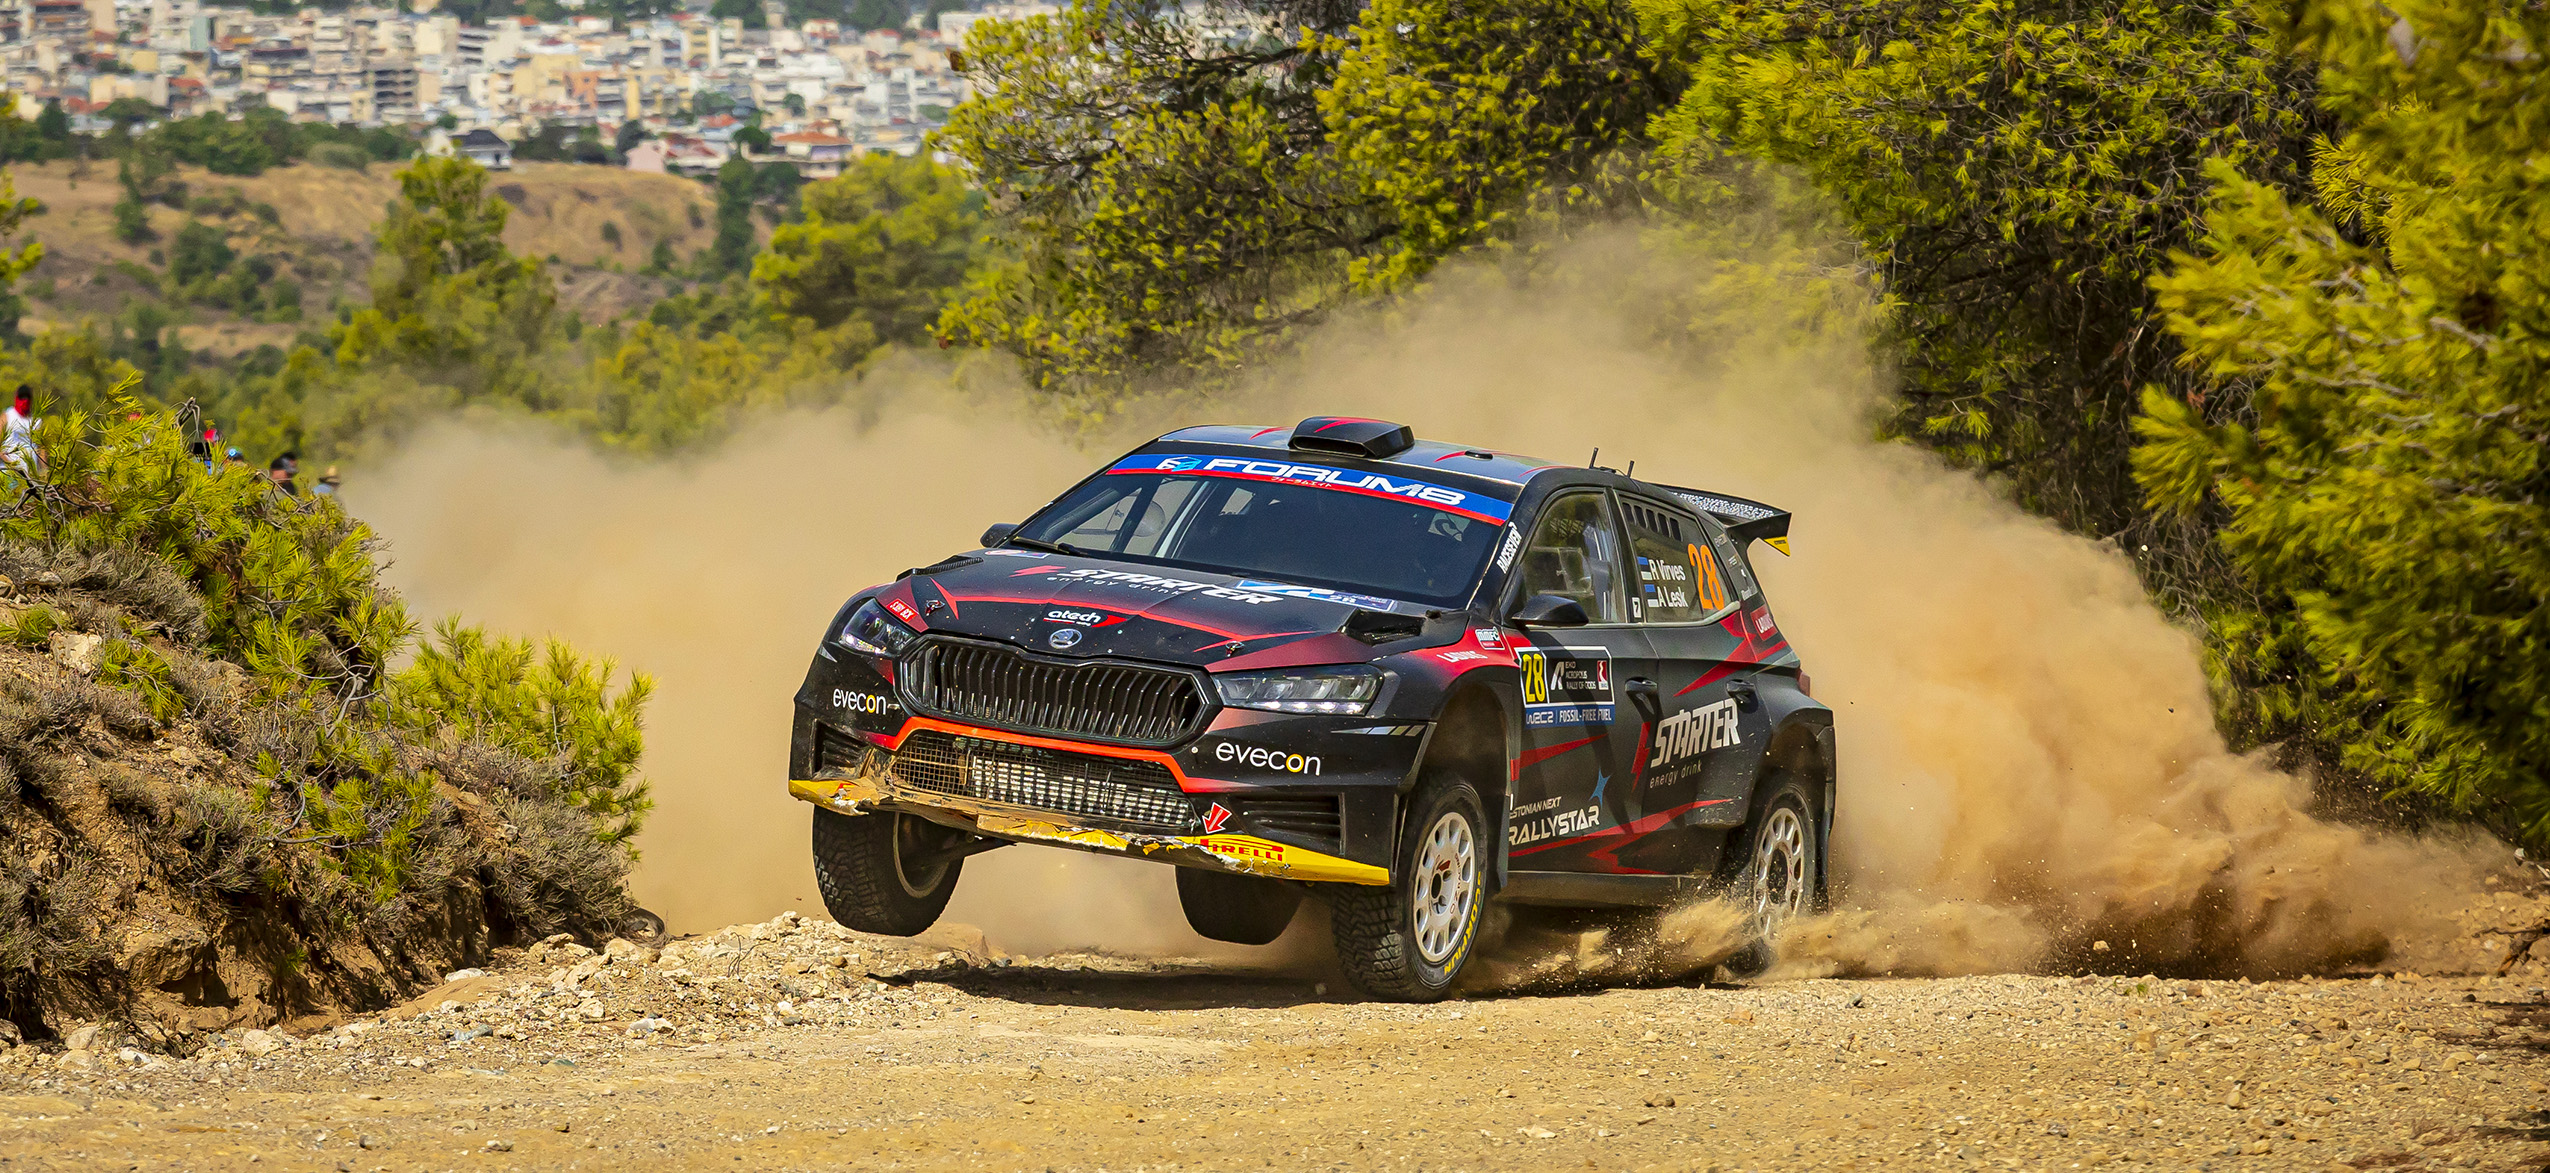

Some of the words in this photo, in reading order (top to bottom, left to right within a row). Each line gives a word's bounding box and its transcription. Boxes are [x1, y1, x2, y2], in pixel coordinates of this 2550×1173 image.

[1203, 458, 1467, 506] FORUM8
[1648, 559, 1660, 580] R
[1656, 559, 1686, 581] Virves
[1687, 543, 1725, 611] 28
[1047, 576, 1120, 587] energy
[1128, 583, 1183, 596] drink
[1057, 568, 1285, 605] STARTER
[1657, 586, 1667, 607] A
[1664, 586, 1689, 608] Lesk
[1047, 610, 1102, 623] atech
[1522, 653, 1546, 703] 28
[832, 688, 887, 715] evecon
[1597, 708, 1612, 721] FUEL
[1650, 698, 1741, 768] STARTER
[1215, 742, 1321, 776] evecon
[1649, 769, 1678, 789] energy
[1680, 760, 1702, 779] drink
[1542, 796, 1562, 810] NEXT
[1508, 805, 1600, 846] RALLYSTAR
